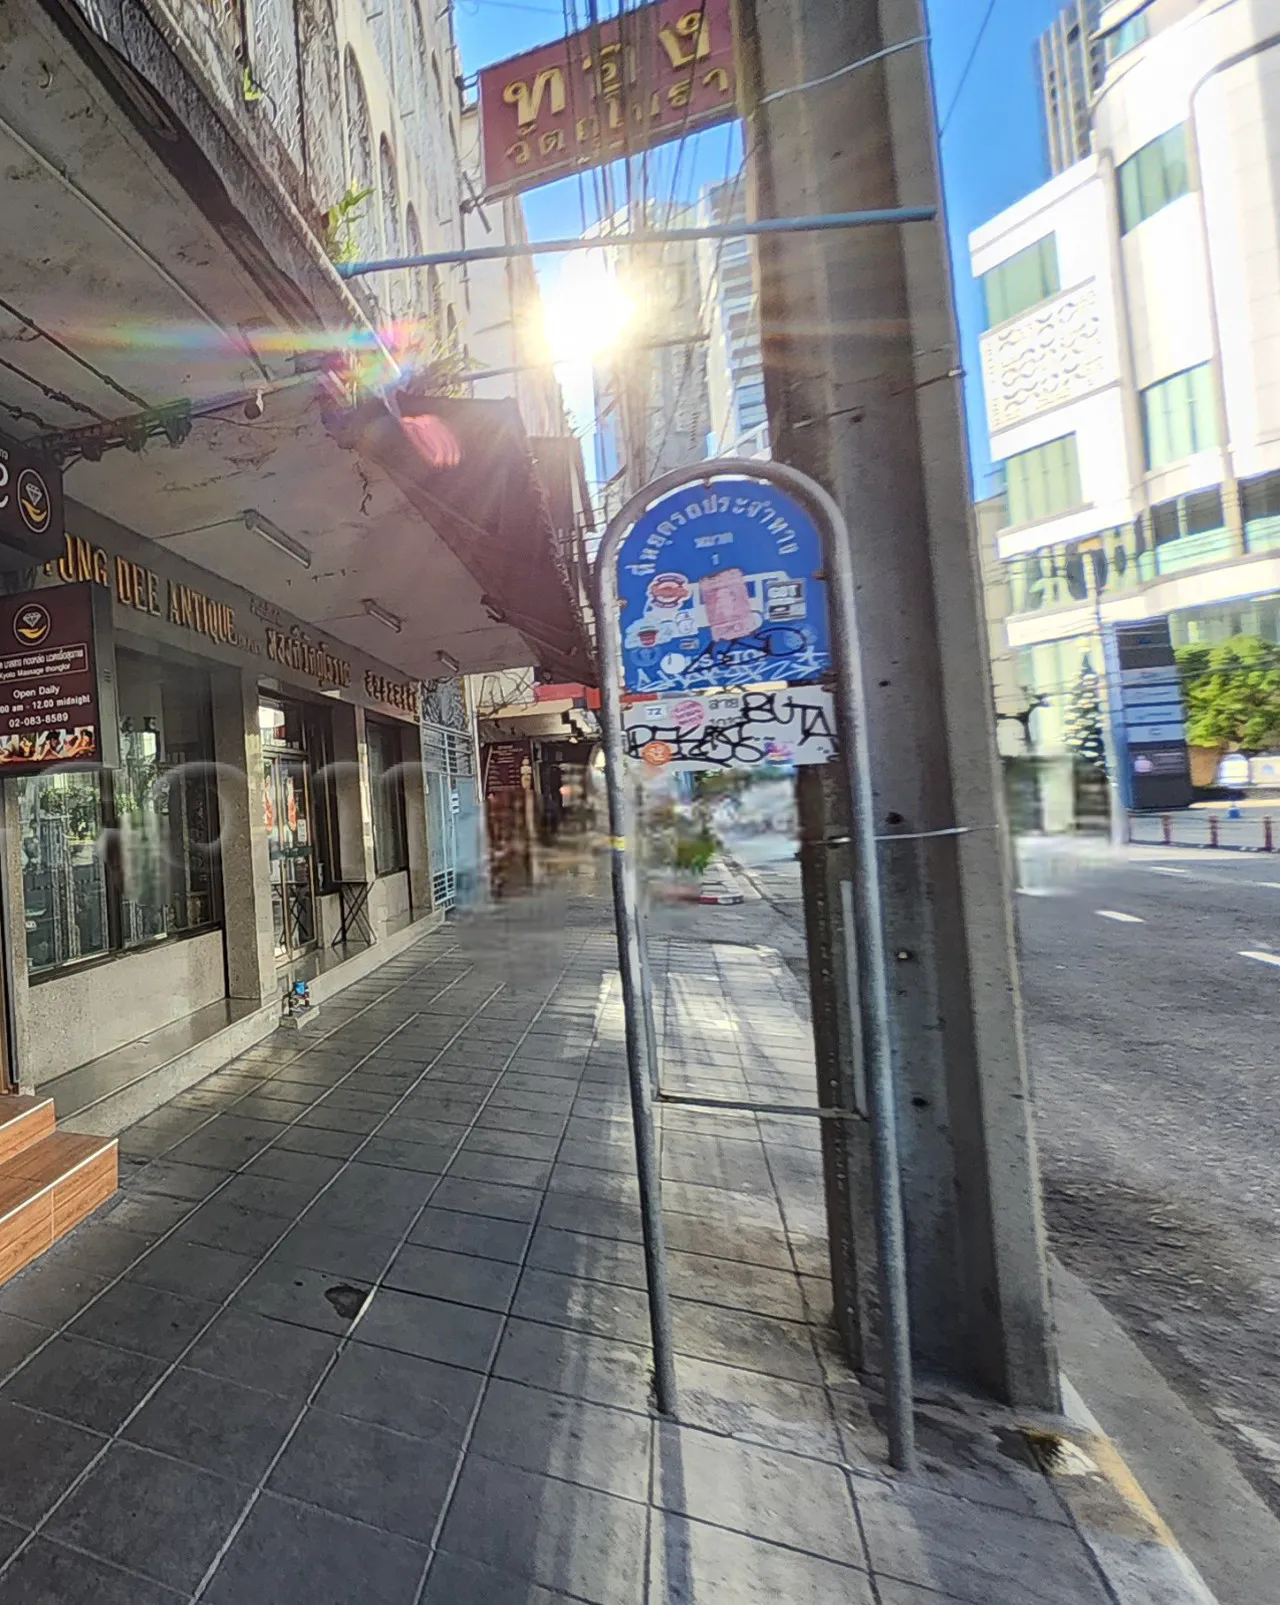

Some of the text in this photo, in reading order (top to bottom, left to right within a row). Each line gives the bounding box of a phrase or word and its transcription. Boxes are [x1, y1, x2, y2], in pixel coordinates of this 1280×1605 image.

[115, 555, 161, 617] DEE
[167, 579, 239, 646] ANTIQUE
[17, 667, 44, 677] Massage
[45, 663, 71, 673] thonglor
[13, 685, 60, 700] Open Daily
[12, 704, 24, 713] am
[32, 699, 54, 710] 12.00
[56, 694, 91, 706] midnight
[8, 712, 69, 728] 02-083-8589
